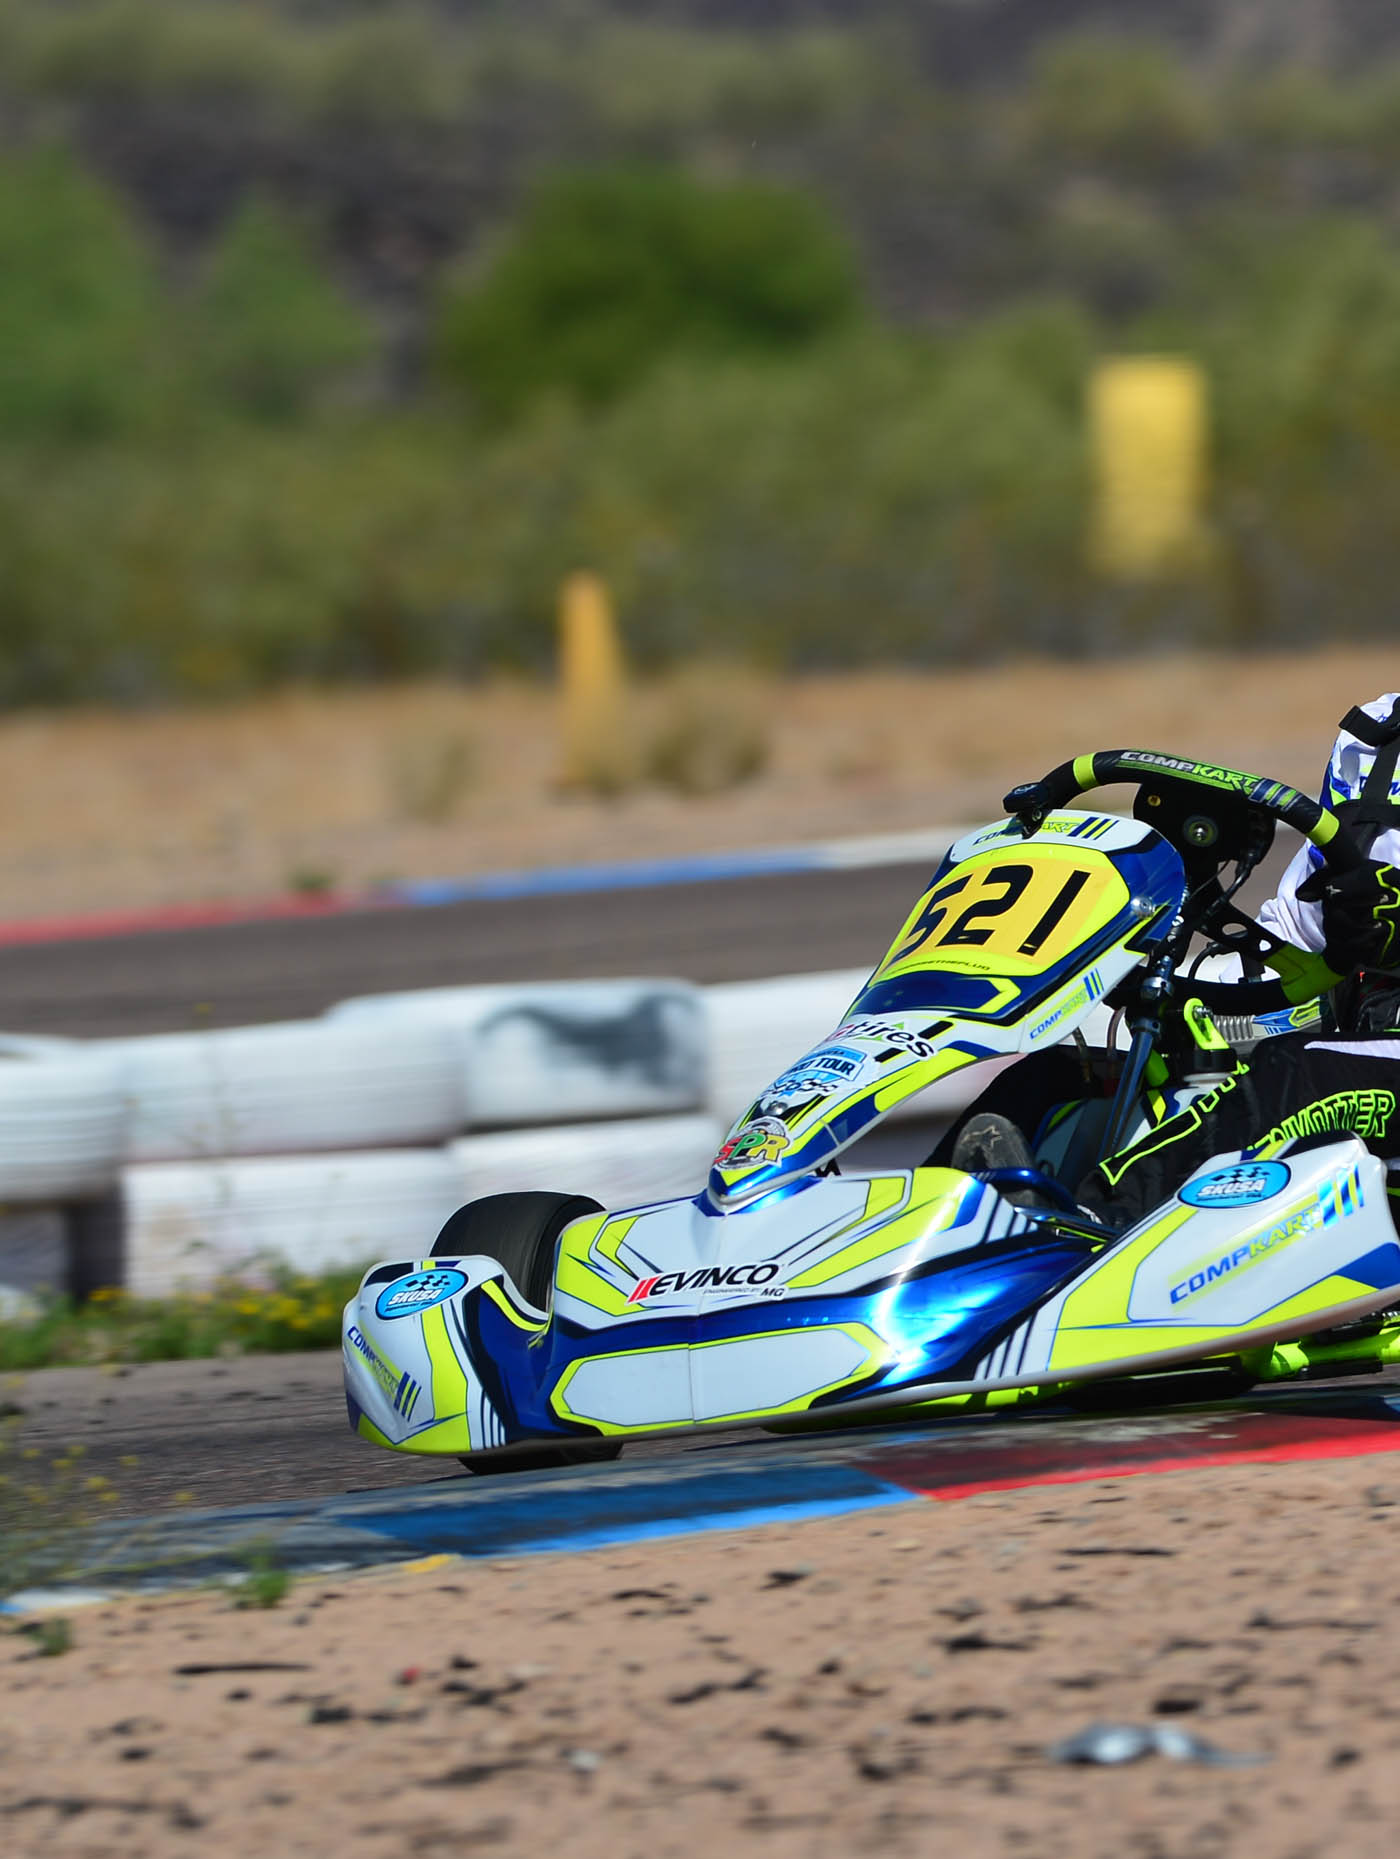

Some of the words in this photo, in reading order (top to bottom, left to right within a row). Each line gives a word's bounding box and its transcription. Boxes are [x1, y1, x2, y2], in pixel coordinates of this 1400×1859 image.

[1120, 751, 1259, 794] COMPKART
[884, 865, 1092, 968] 521
[816, 1057, 855, 1076] TOUR
[714, 1132, 790, 1163] SPR
[1197, 1178, 1267, 1197] SKUSA
[388, 1287, 445, 1306] SKUSA
[760, 1287, 785, 1297] MG
